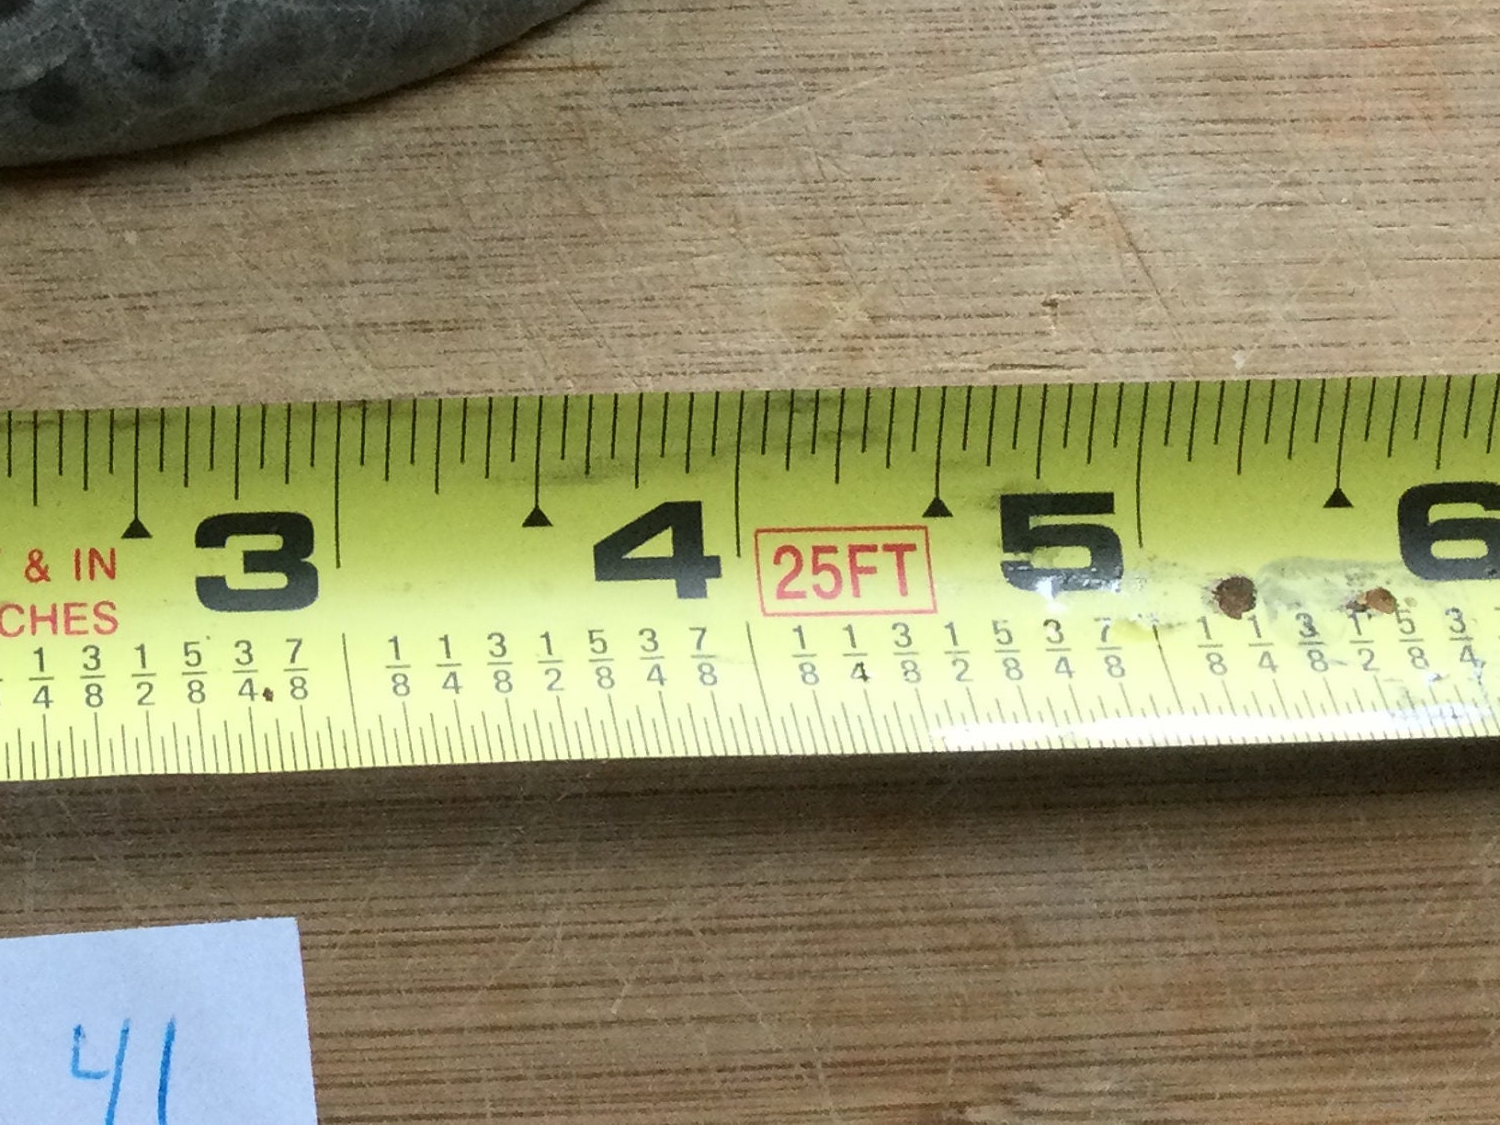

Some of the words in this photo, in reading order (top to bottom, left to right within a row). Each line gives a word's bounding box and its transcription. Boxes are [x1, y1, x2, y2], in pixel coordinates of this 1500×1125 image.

[25, 549, 51, 583] &
[74, 548, 117, 581] IN
[195, 511, 319, 611] 3
[593, 501, 722, 599] 4
[773, 543, 917, 600] 25FT
[1000, 492, 1123, 592] 5
[1398, 482, 1500, 581] 6
[70, 1015, 177, 1125] 41
